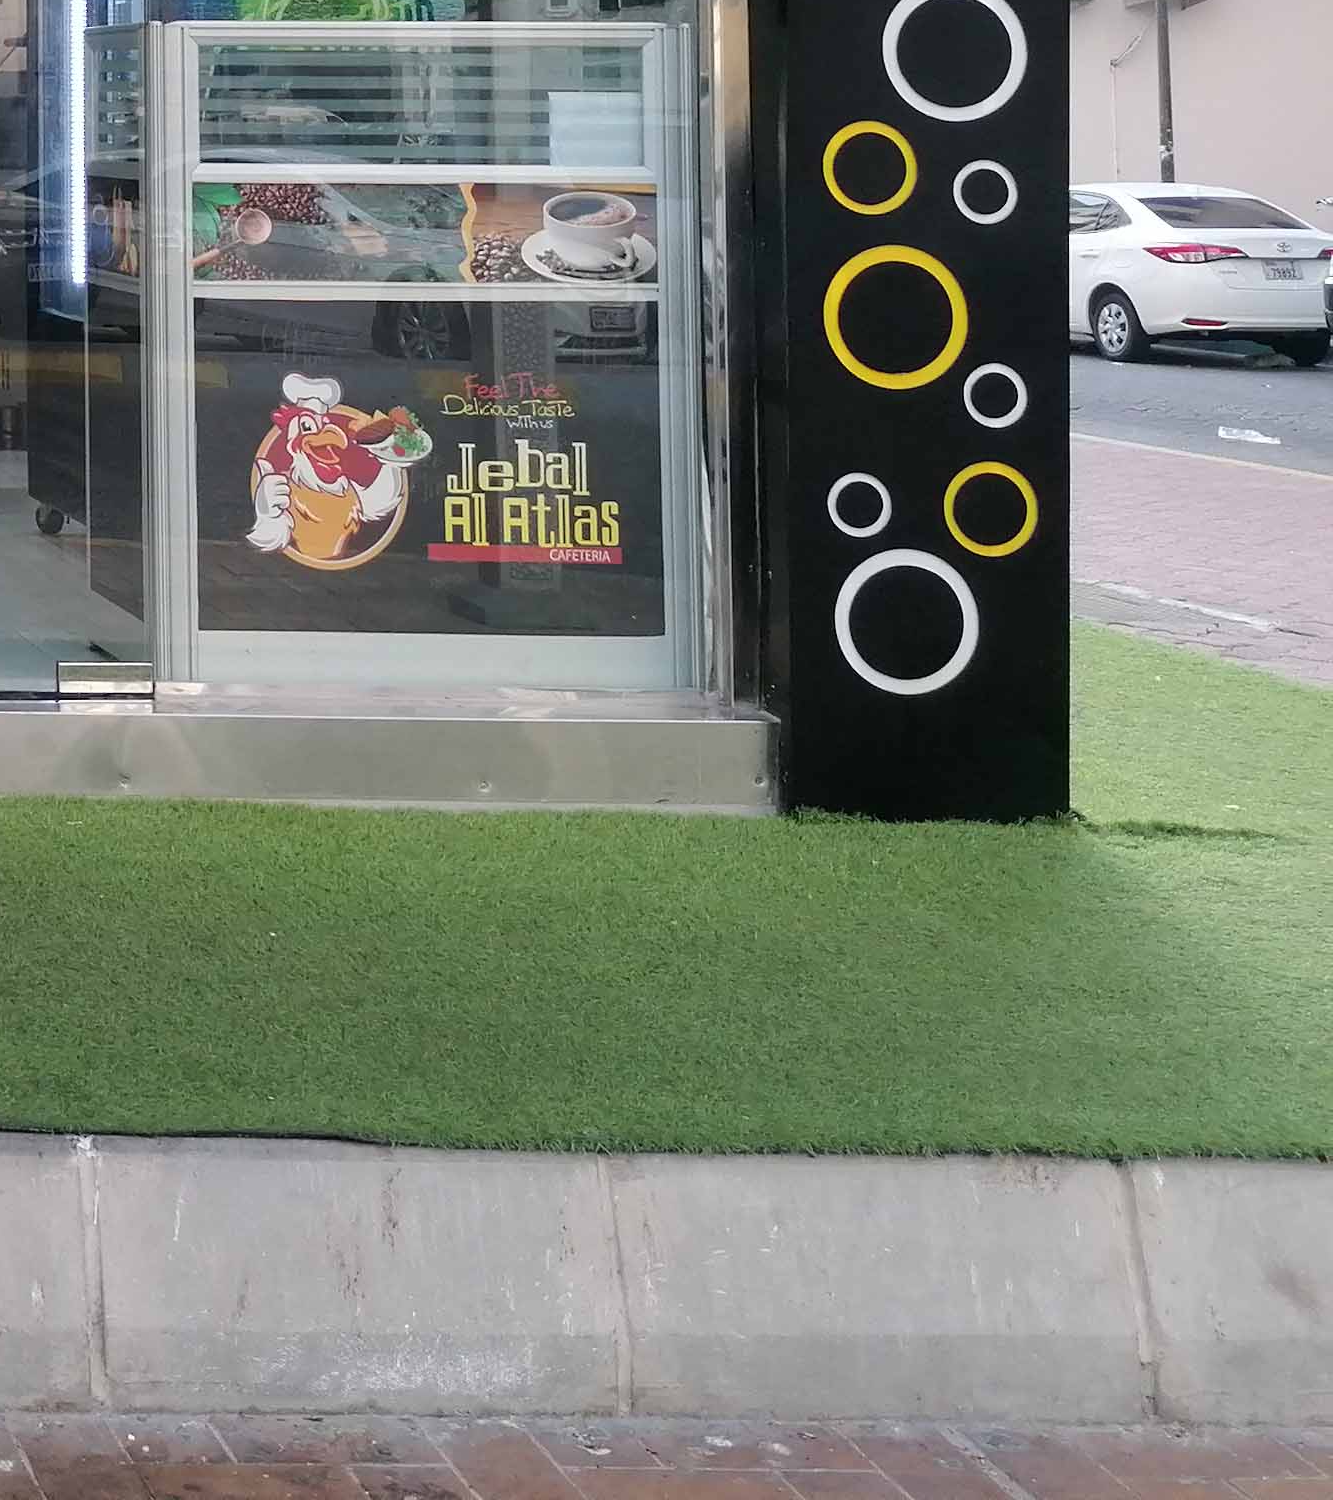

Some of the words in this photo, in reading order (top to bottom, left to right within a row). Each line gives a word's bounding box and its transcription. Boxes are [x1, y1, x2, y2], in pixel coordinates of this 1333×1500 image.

[463, 373, 510, 399] Feel
[439, 394, 519, 418] Delicious
[446, 438, 591, 496] Jebal
[443, 493, 490, 547] Al
[503, 493, 620, 549] Atlas
[549, 548, 611, 564] CAFETERIA
